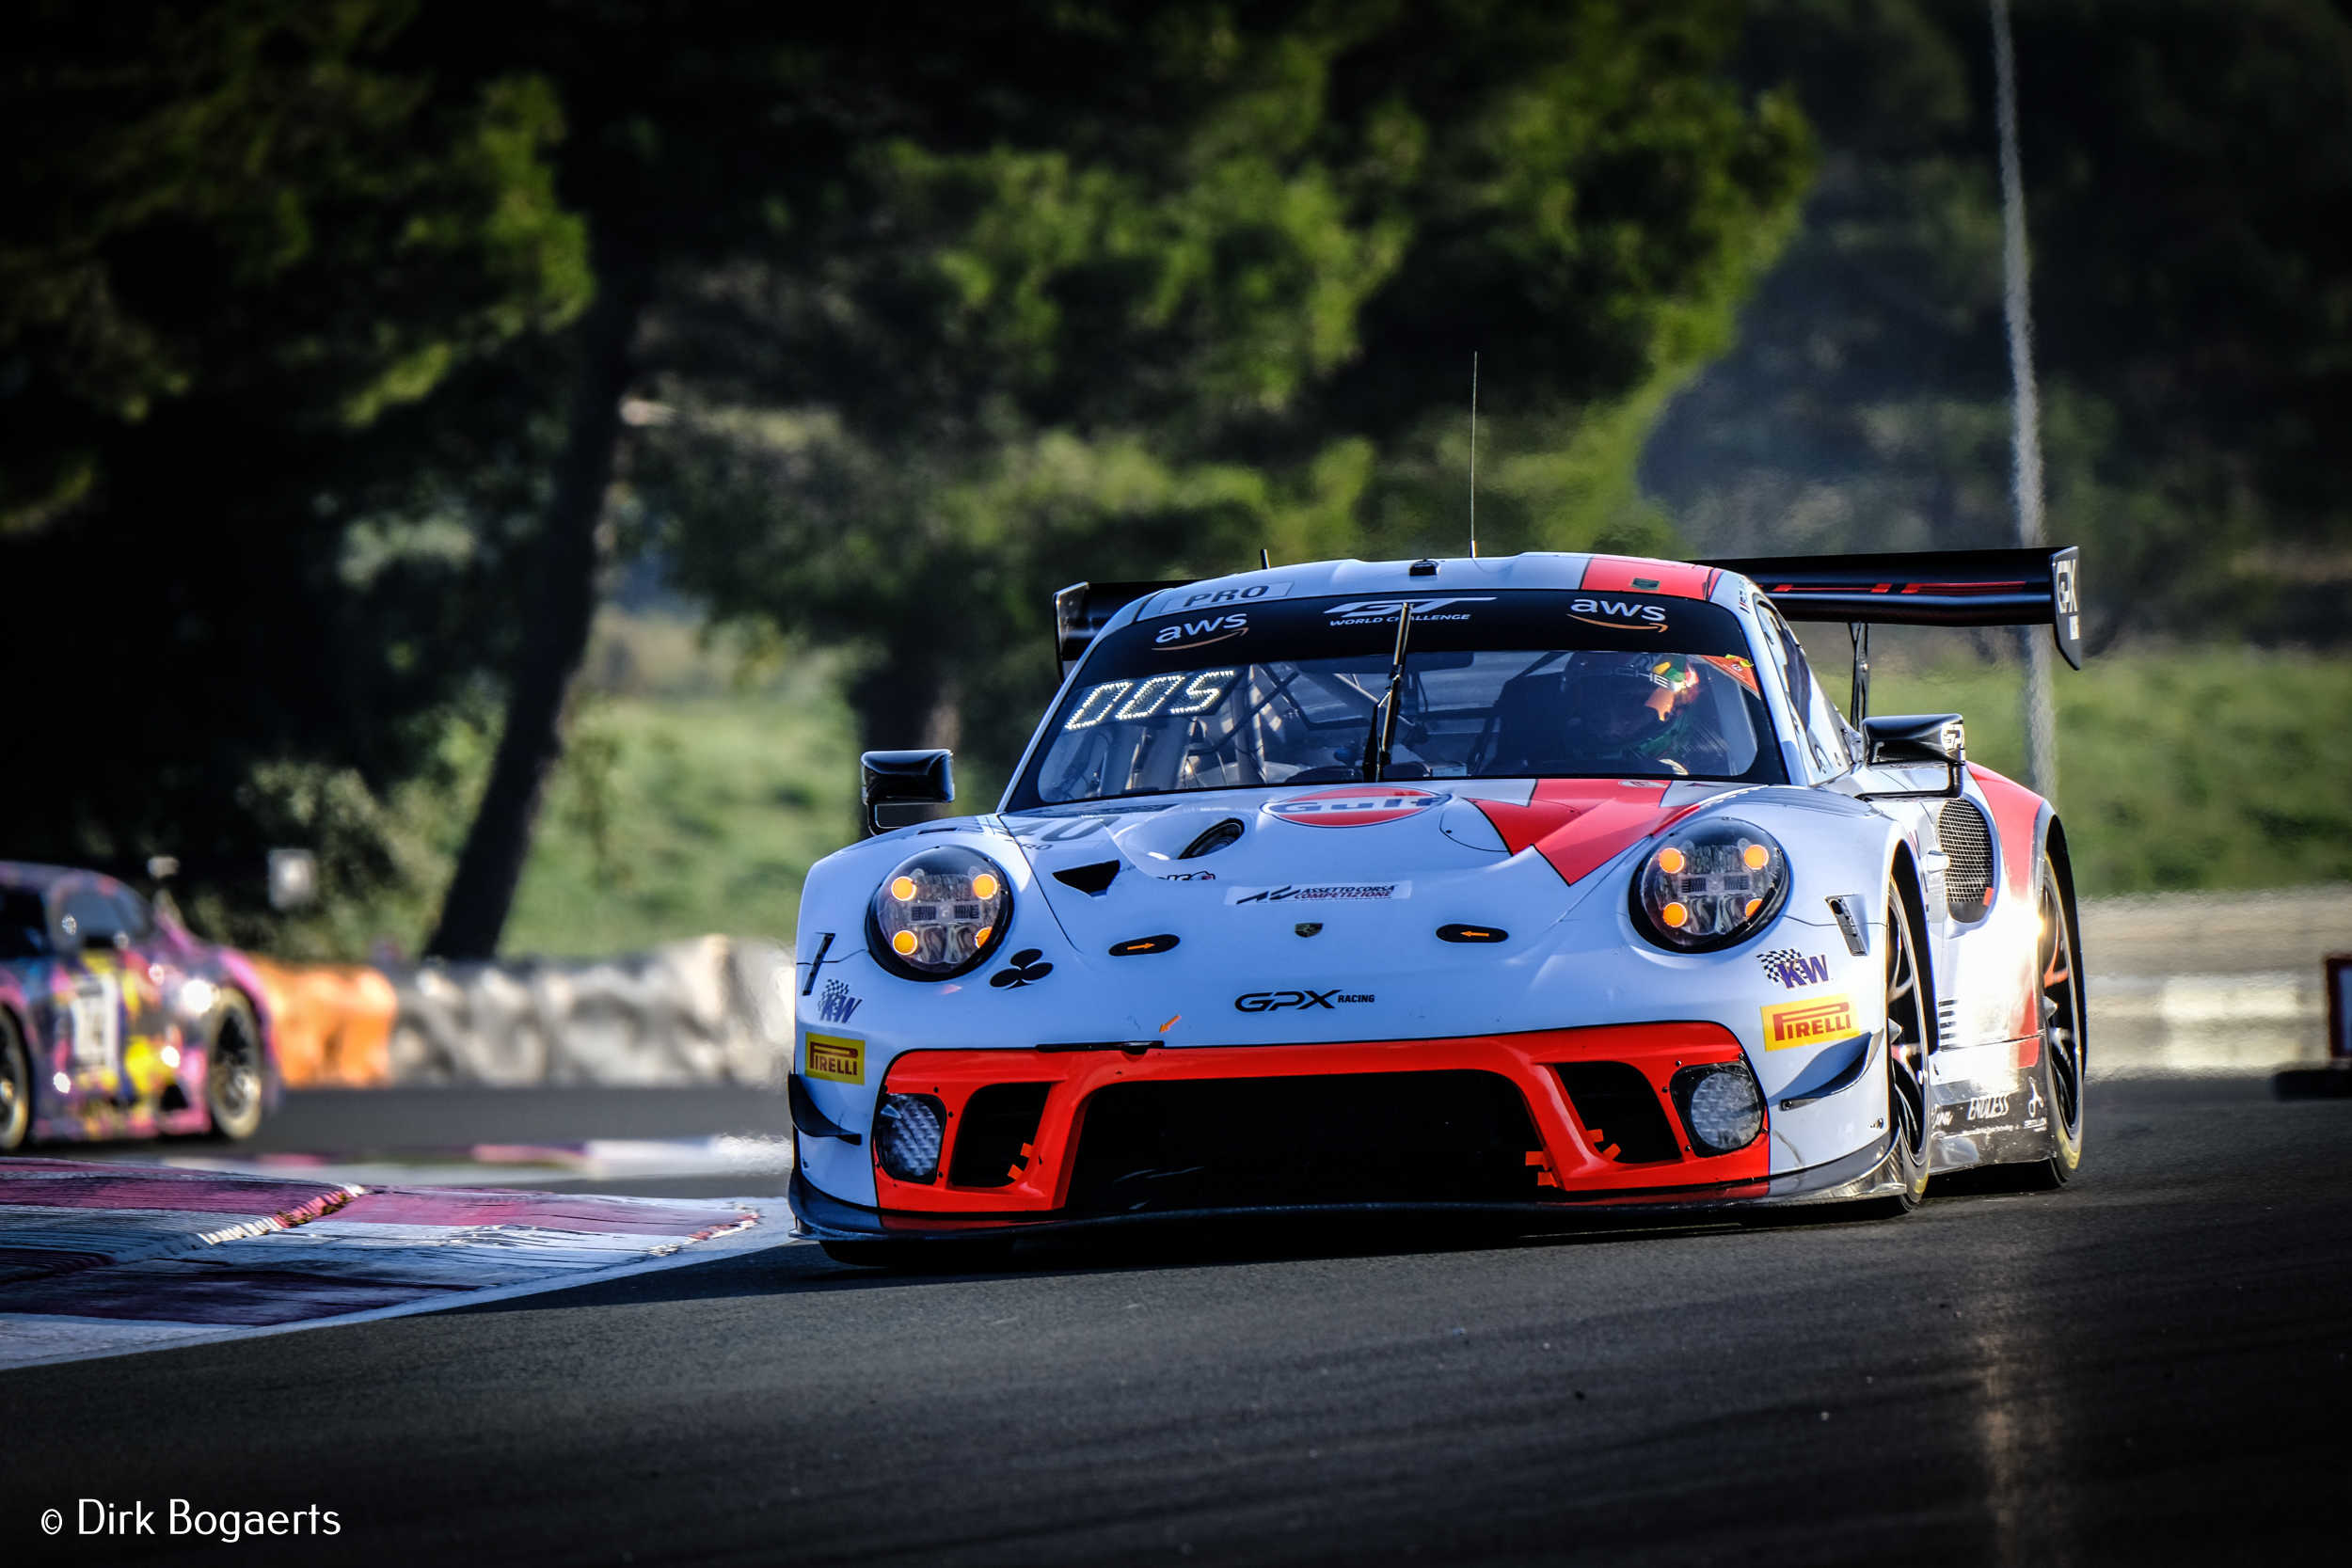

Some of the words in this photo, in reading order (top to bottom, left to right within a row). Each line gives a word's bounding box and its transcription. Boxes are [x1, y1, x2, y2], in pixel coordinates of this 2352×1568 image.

[1184, 586, 1269, 608] PRO
[1329, 616, 1383, 626] WORLD
[1570, 598, 1666, 622] aws
[1155, 613, 1248, 643] aws
[1356, 884, 1396, 894] CORSA
[1776, 954, 1829, 989] KW
[819, 993, 863, 1024] KW
[1234, 990, 1343, 1012] GPX
[1337, 994, 1375, 1004] RACING
[1772, 1002, 1851, 1041] PIRELLI
[810, 1041, 858, 1076] PIRELLI
[1967, 1096, 2010, 1120] ENDLESS
